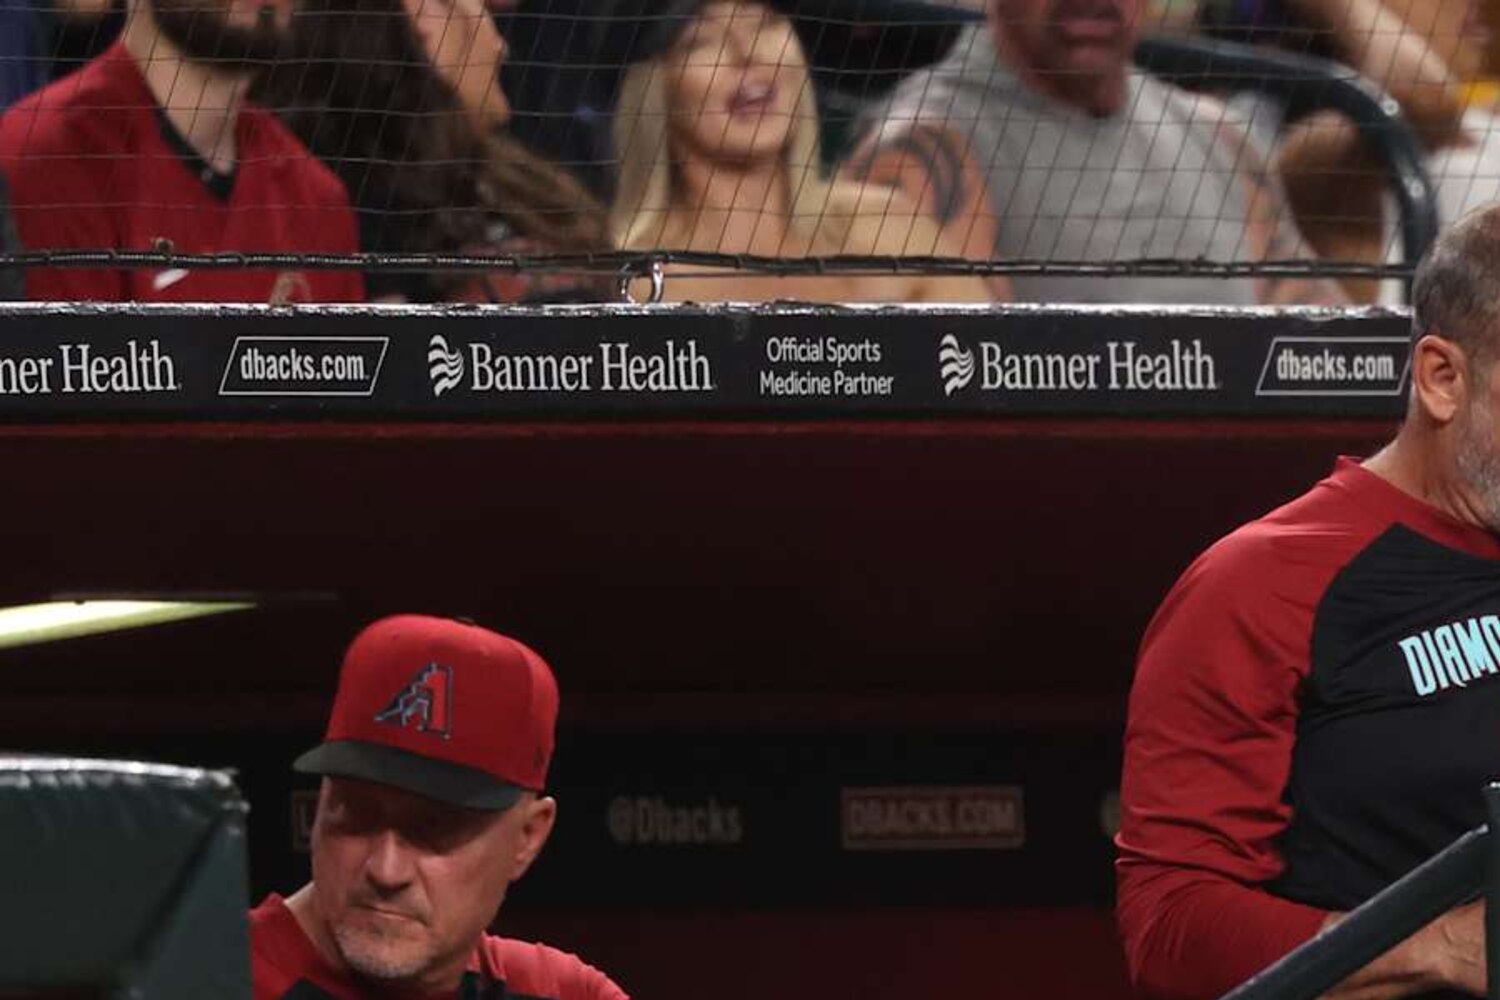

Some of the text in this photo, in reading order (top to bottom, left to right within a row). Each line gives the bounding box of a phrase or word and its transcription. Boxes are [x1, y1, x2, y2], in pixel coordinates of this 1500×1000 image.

[59, 340, 178, 392] Health
[240, 347, 366, 381] dbacks.com
[470, 340, 713, 391] Banner Health
[766, 336, 881, 368] Official Sports
[980, 340, 1216, 390] Banner Health
[1276, 347, 1394, 381] dbacks.com
[760, 369, 894, 395] Medicine Partner
